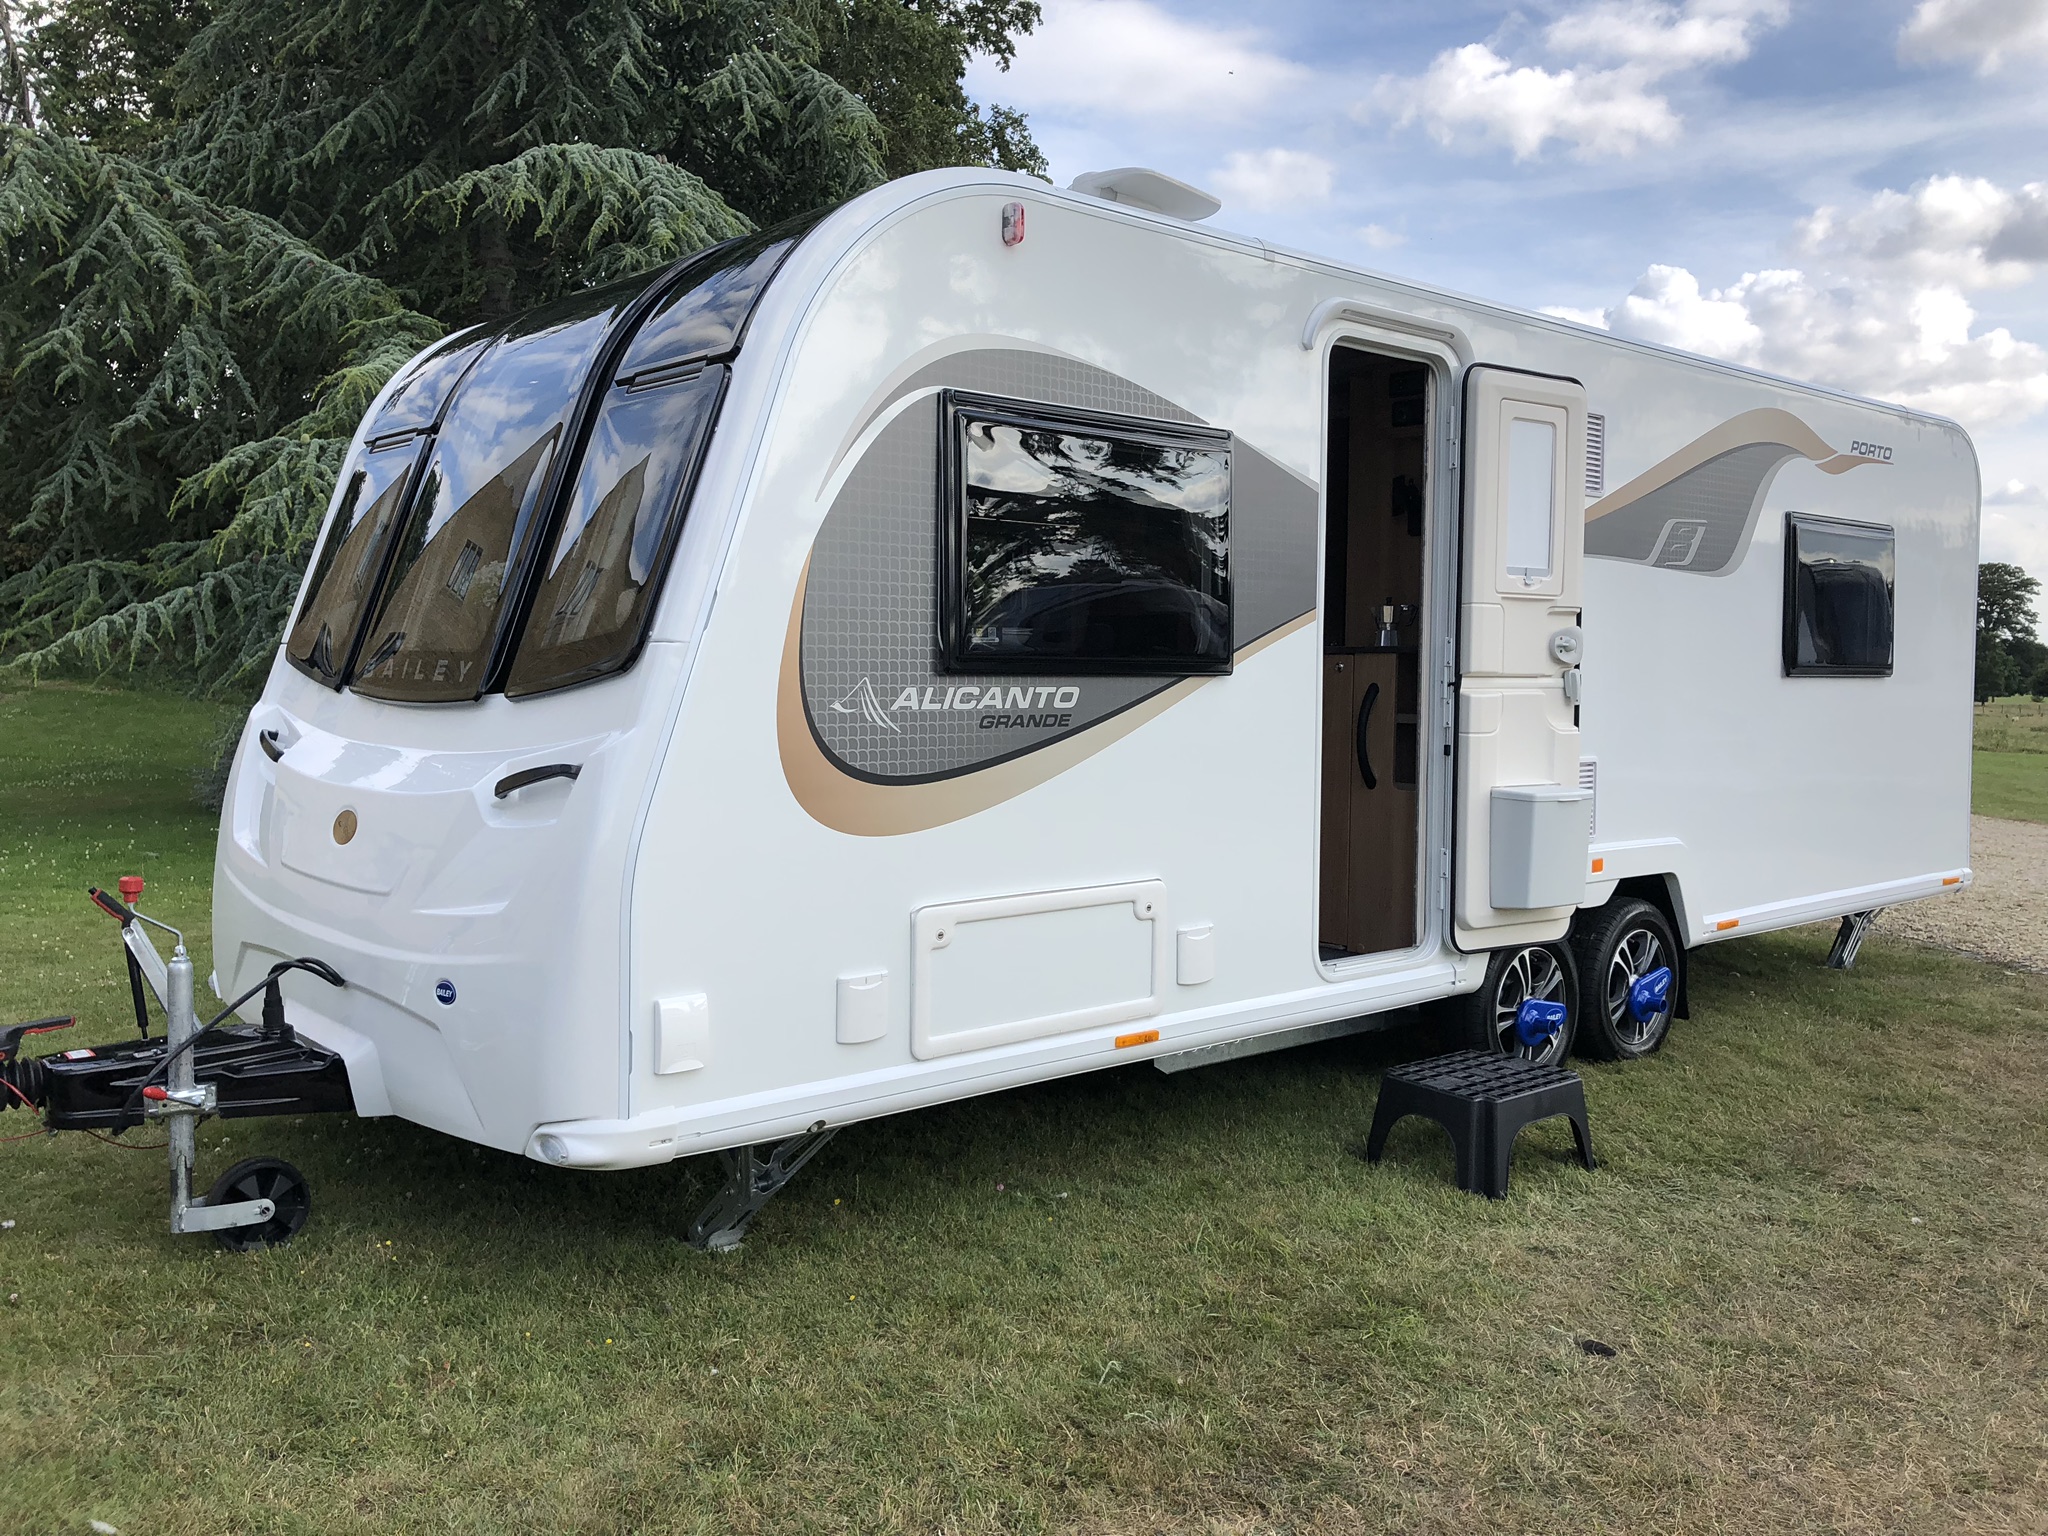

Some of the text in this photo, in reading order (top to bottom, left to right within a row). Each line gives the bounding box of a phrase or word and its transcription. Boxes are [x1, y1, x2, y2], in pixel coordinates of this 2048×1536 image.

[1850, 440, 1893, 460] PORTO
[362, 658, 473, 682] AILEY
[890, 686, 1080, 711] ALICANTO
[978, 713, 1073, 729] GRANDE
